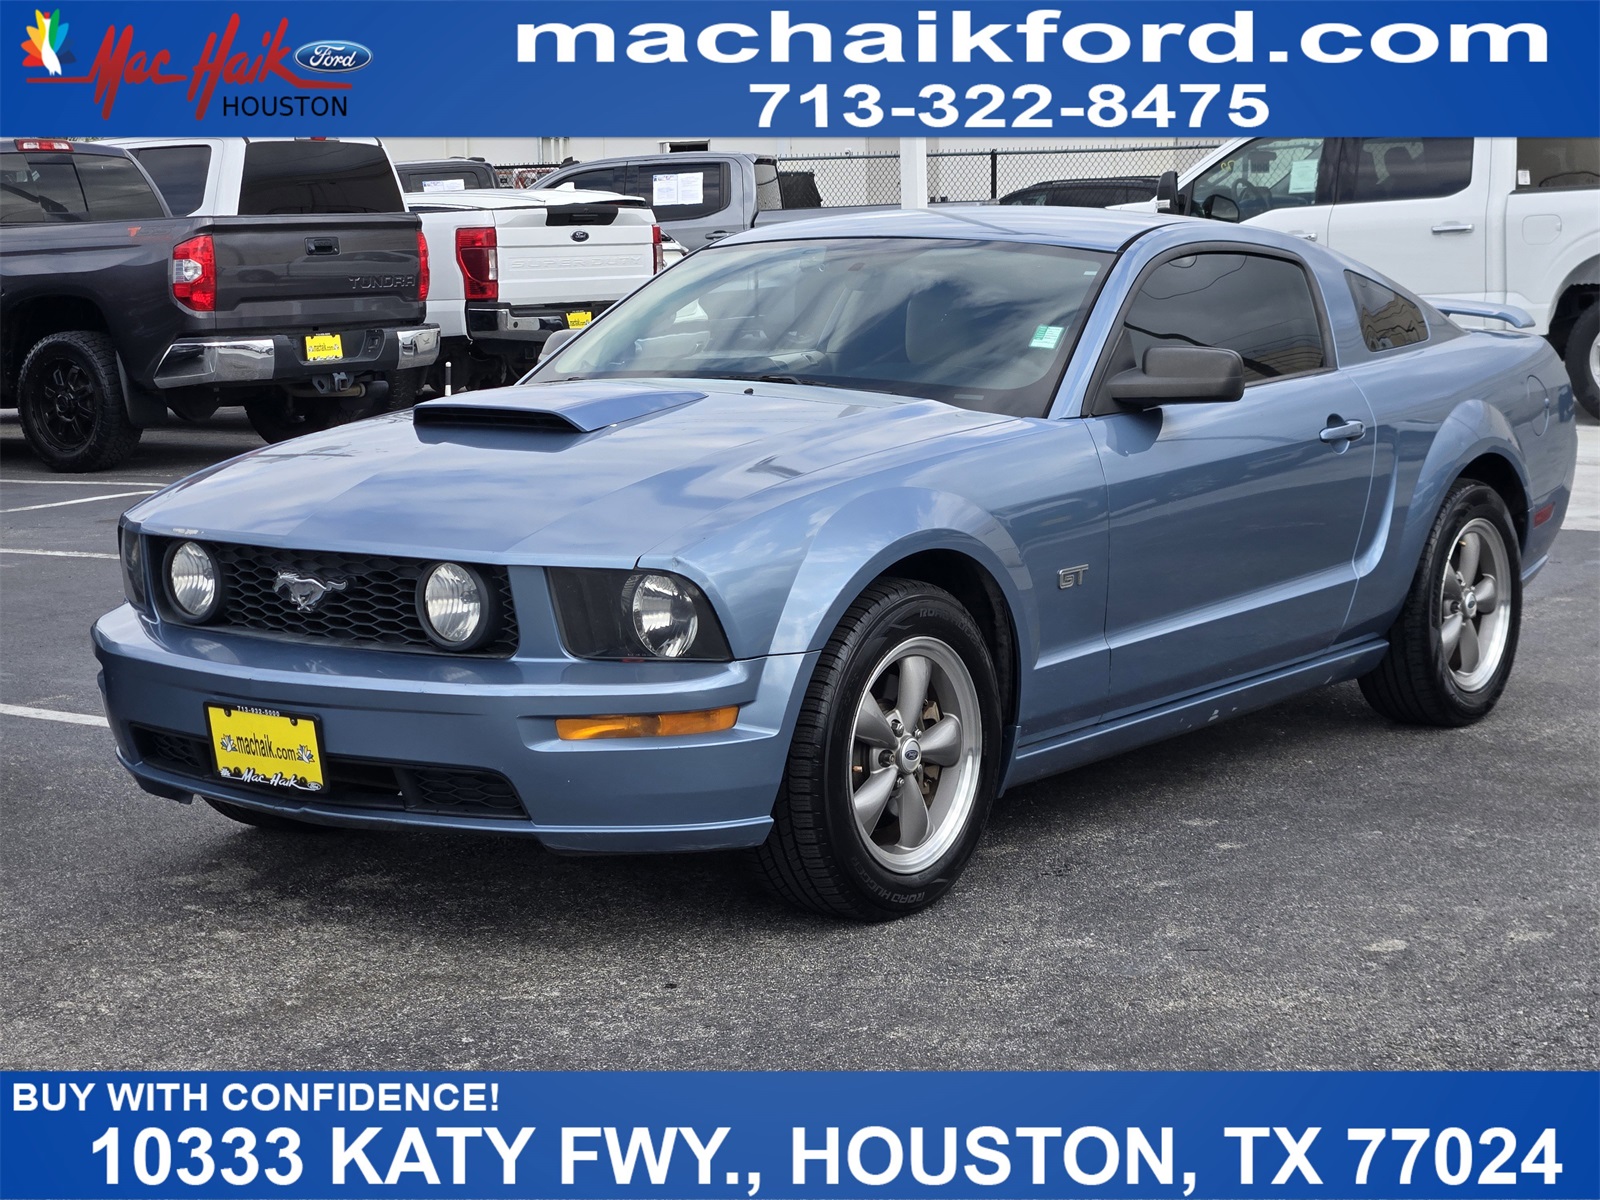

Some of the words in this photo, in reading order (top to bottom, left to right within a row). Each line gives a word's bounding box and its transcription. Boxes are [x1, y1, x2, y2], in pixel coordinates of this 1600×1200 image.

[348, 275, 416, 289] TUNDRA
[1057, 563, 1089, 590] GT
[235, 733, 297, 762] machaik.com
[241, 768, 267, 784] Mac
[269, 773, 298, 789] Haik
